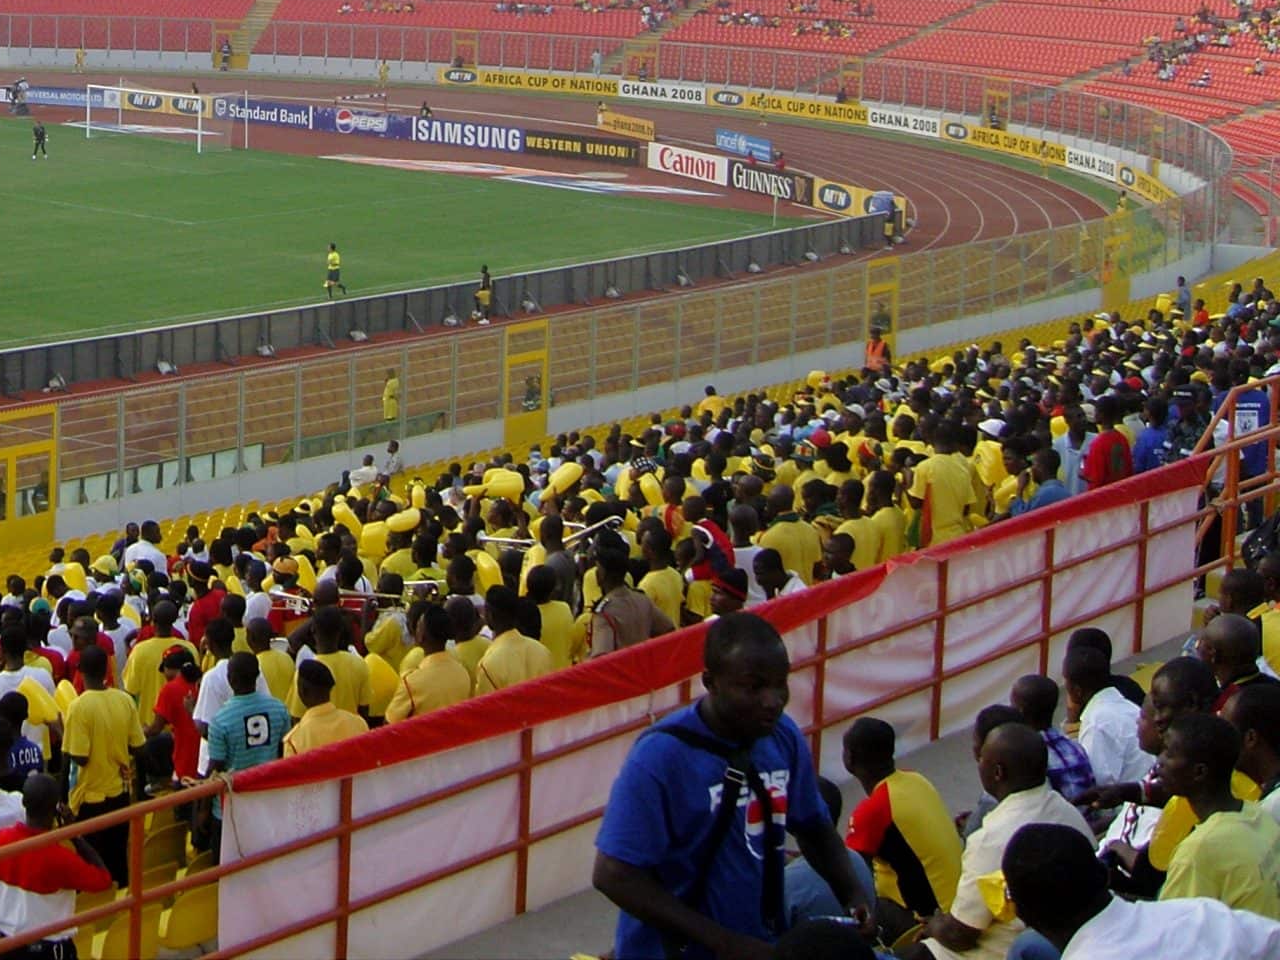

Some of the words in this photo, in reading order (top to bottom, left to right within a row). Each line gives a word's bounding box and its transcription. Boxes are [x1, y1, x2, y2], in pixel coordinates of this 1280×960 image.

[449, 71, 472, 82] MTN
[485, 72, 521, 86] AFRICA
[527, 76, 548, 87] CUP
[552, 77, 566, 89] OF
[570, 80, 618, 93] NATIONS
[133, 93, 157, 106] MTN
[622, 83, 667, 98] GHANA
[671, 88, 703, 101] 2008
[229, 103, 277, 122] Standard
[279, 108, 309, 125] Bank
[750, 95, 782, 111] AFICA
[787, 101, 805, 113] CUP
[809, 104, 822, 115] OF
[825, 106, 867, 121] NATIONS
[352, 116, 386, 131] PEPSI
[871, 112, 909, 129] GHANA
[913, 118, 937, 134] 2008
[417, 118, 520, 151] SAMSUNG
[1003, 135, 1017, 149] CUP
[526, 135, 581, 153] WESTERN
[586, 143, 627, 158] UNION
[659, 146, 716, 181] Canon
[1068, 151, 1096, 170] GHANA
[732, 162, 792, 200] GUINNESS
[823, 188, 846, 206] MTN
[246, 714, 269, 746] 9
[18, 747, 40, 766] COLE
